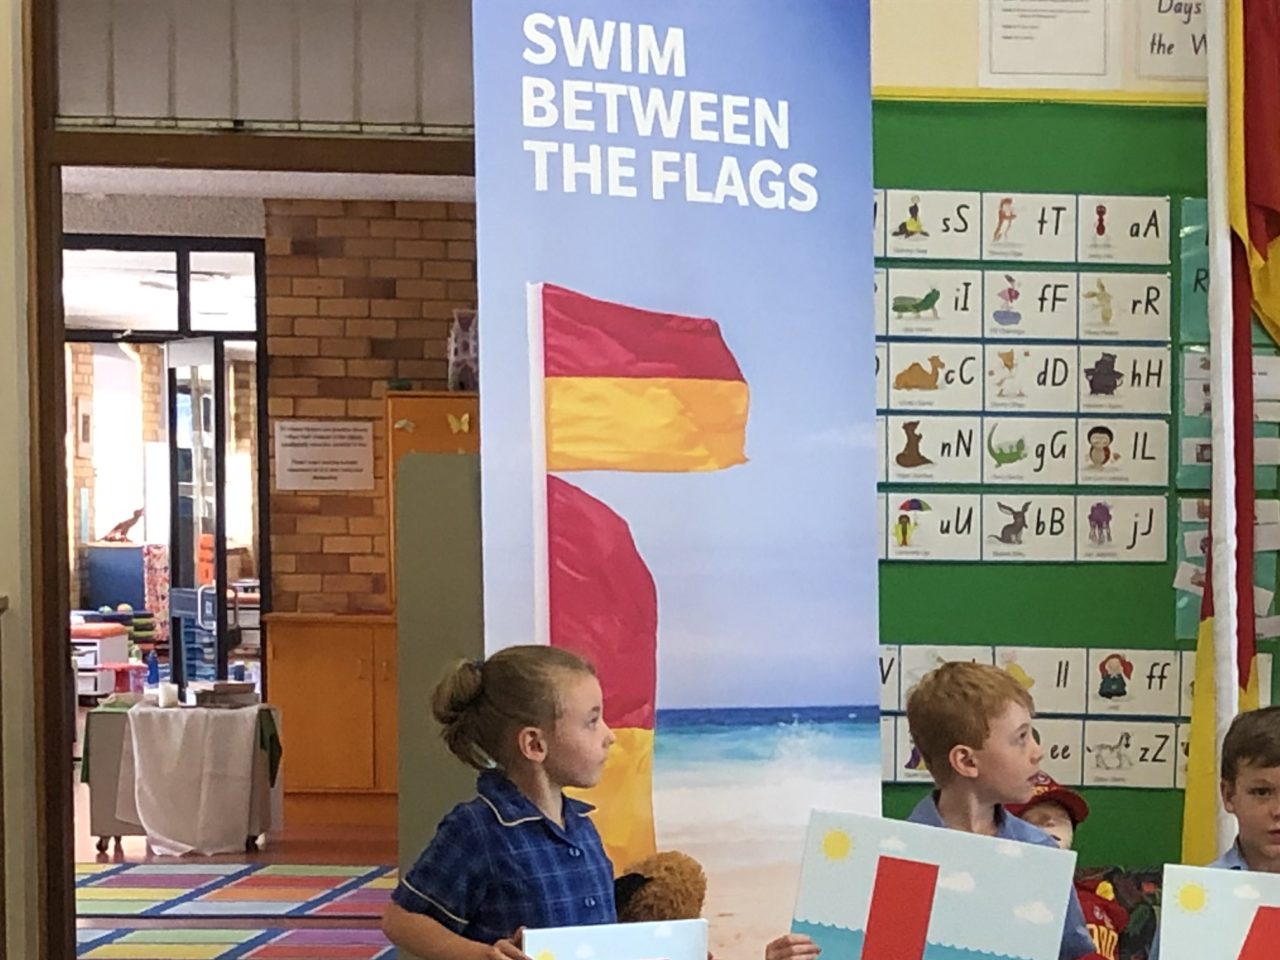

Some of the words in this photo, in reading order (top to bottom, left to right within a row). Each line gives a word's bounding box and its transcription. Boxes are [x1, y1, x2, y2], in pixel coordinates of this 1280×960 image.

[1157, 0, 1202, 24] Days
[522, 12, 686, 77] SWIM
[1149, 33, 1175, 55] the
[522, 75, 789, 149] BETWEEN
[522, 139, 638, 198] THE
[651, 149, 819, 212] FLAGS
[941, 204, 970, 233] sS
[1037, 206, 1067, 236] tT
[1129, 209, 1160, 239] aA
[953, 281, 973, 311] iI
[1037, 284, 1069, 313] fF
[1131, 286, 1161, 315] rR
[944, 356, 976, 386] cC
[1036, 357, 1069, 387] dD
[1130, 359, 1163, 388] hH
[940, 429, 973, 458] nN
[1033, 430, 1068, 473] gG
[940, 506, 973, 535] uU
[1035, 507, 1065, 536] bB
[1126, 507, 1155, 550] jJ
[1146, 662, 1171, 690] ff
[1138, 734, 1170, 763] zZ
